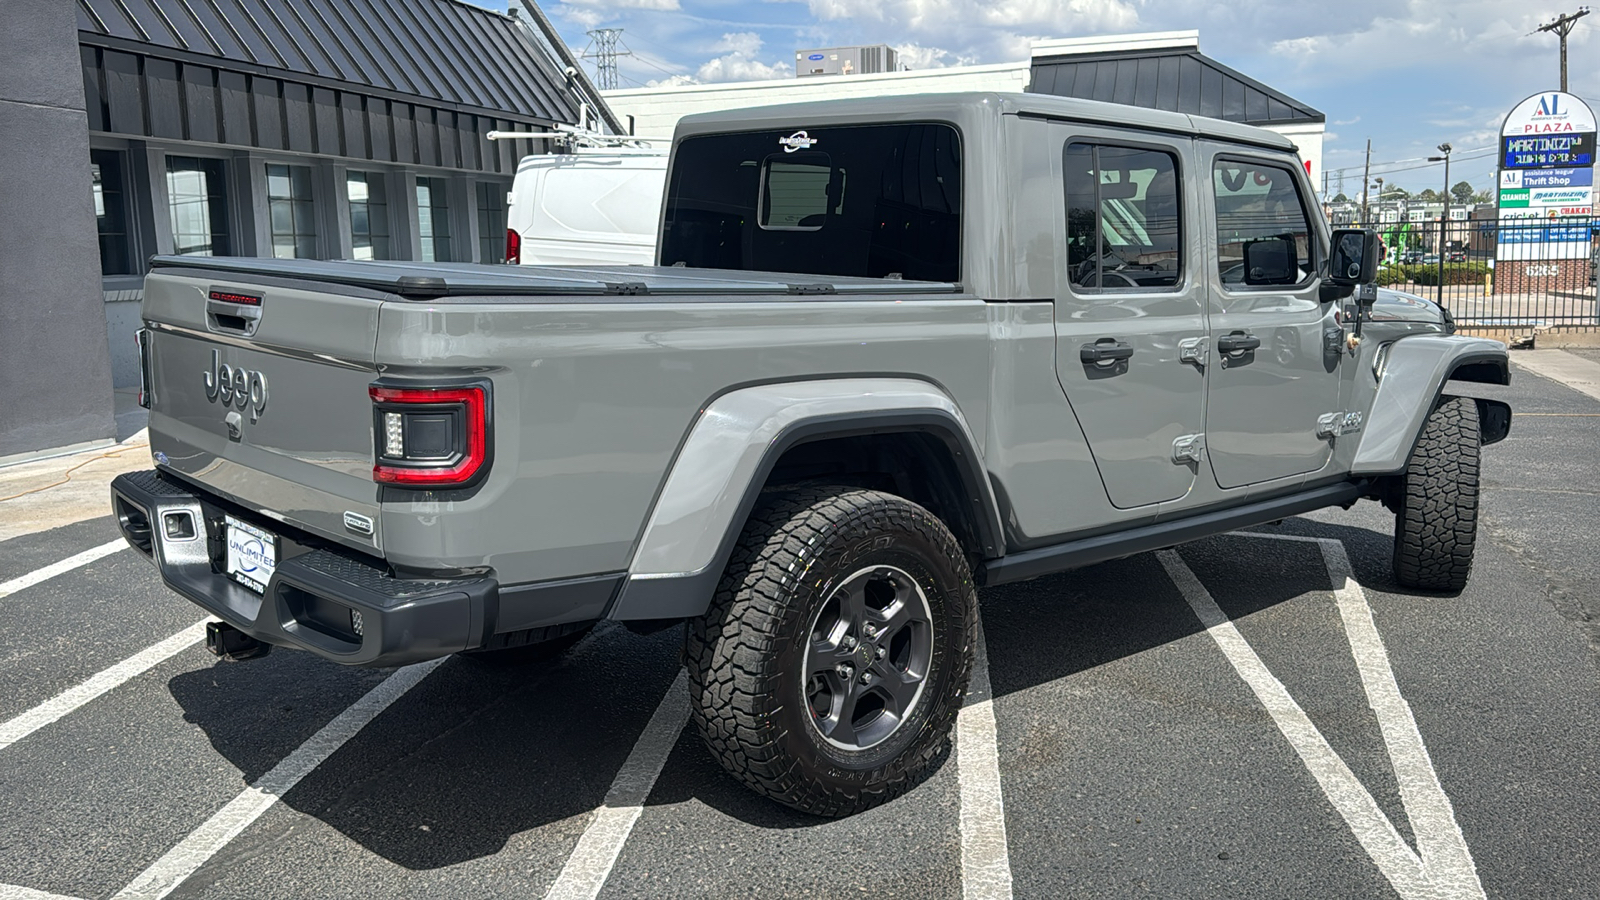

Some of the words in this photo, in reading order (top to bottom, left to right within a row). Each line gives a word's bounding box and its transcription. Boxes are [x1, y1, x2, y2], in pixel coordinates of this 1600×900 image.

[1532, 94, 1568, 116] AL
[1524, 122, 1573, 133] PLAZA
[1554, 168, 1574, 176] league
[1524, 177, 1546, 186] Thrift
[1548, 176, 1570, 186] Shop
[1501, 193, 1529, 201] CLEANERS
[1534, 191, 1588, 200] MARTINIZING
[203, 348, 267, 420] Jeep
[229, 539, 276, 568] UNLIMITED
